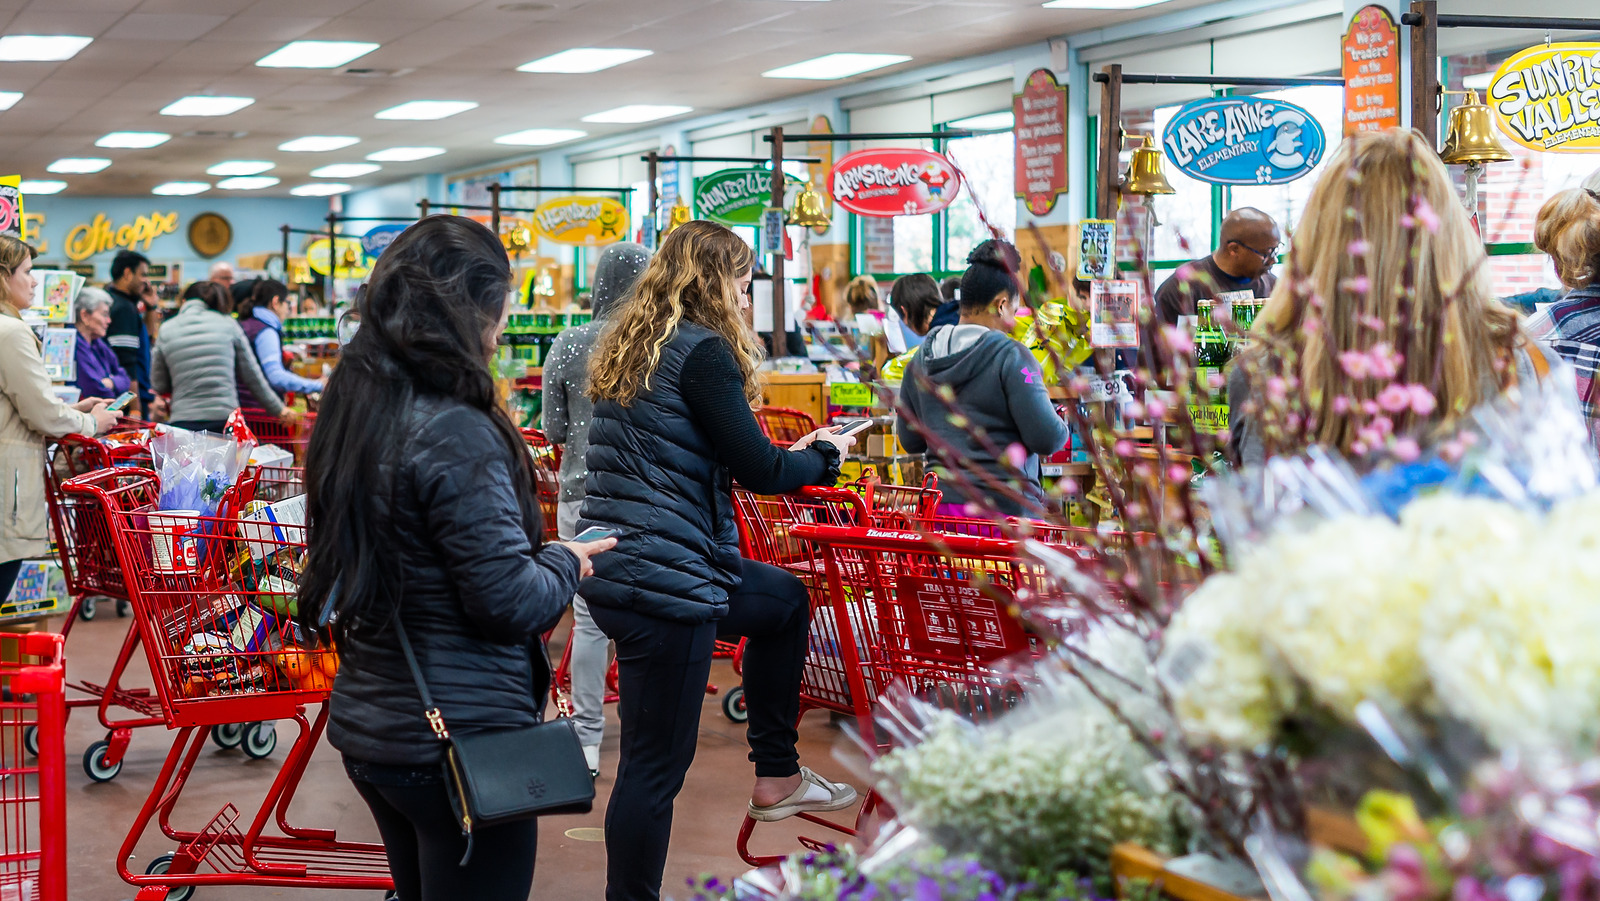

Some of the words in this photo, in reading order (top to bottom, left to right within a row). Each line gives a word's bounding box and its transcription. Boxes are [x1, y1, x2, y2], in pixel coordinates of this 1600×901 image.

[1492, 51, 1600, 116] SUNRIS
[1509, 88, 1600, 142] VALLE
[1165, 110, 1225, 167] LAKE
[1223, 101, 1276, 146] ANNE
[1543, 126, 1600, 149] ELEMENTA
[1197, 139, 1260, 171] ELEMENTARY
[833, 162, 920, 202] ARMSTRONG
[537, 202, 602, 232] HERNDON
[64, 211, 178, 261] Shoppe
[1082, 239, 1109, 254] CART
[866, 529, 899, 539] TRADER
[924, 583, 955, 594] TRAER
[958, 586, 980, 597] JOE'S
